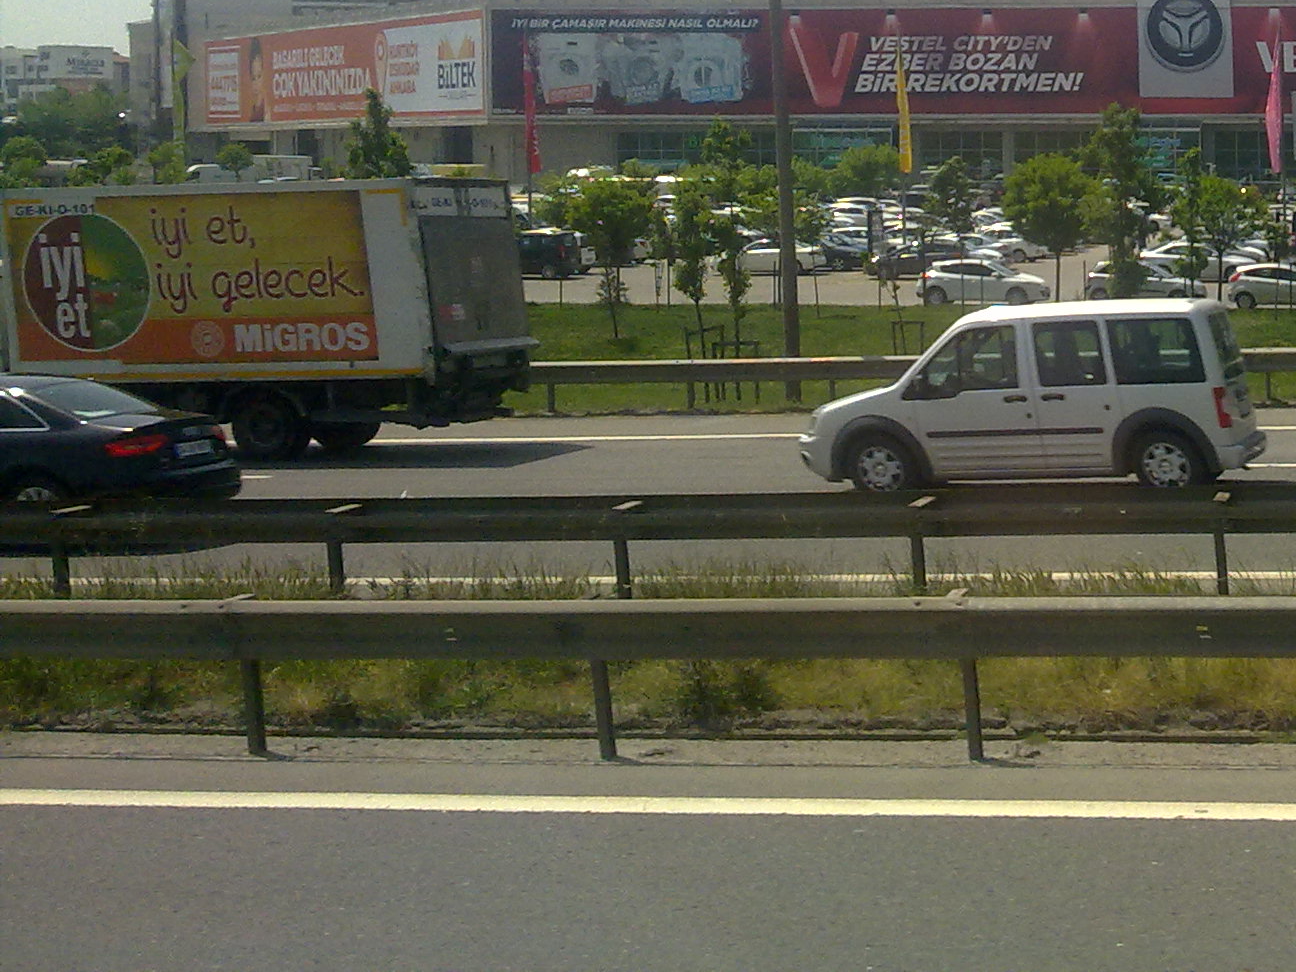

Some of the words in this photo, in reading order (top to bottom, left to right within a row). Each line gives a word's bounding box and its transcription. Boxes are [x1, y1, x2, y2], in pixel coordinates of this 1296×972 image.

[667, 18, 703, 28] NASIL
[706, 18, 759, 28] OLMALI?
[870, 36, 946, 51] VESTEL
[861, 53, 945, 71] EZBER
[947, 53, 1038, 71] BOZAN
[905, 72, 1084, 93] REKORTMEN!
[151, 207, 193, 259] iyi
[206, 205, 257, 248] et,
[38, 232, 85, 300] iyi
[156, 262, 198, 314] iyi
[211, 256, 366, 313] gelecek.
[56, 293, 91, 339] et
